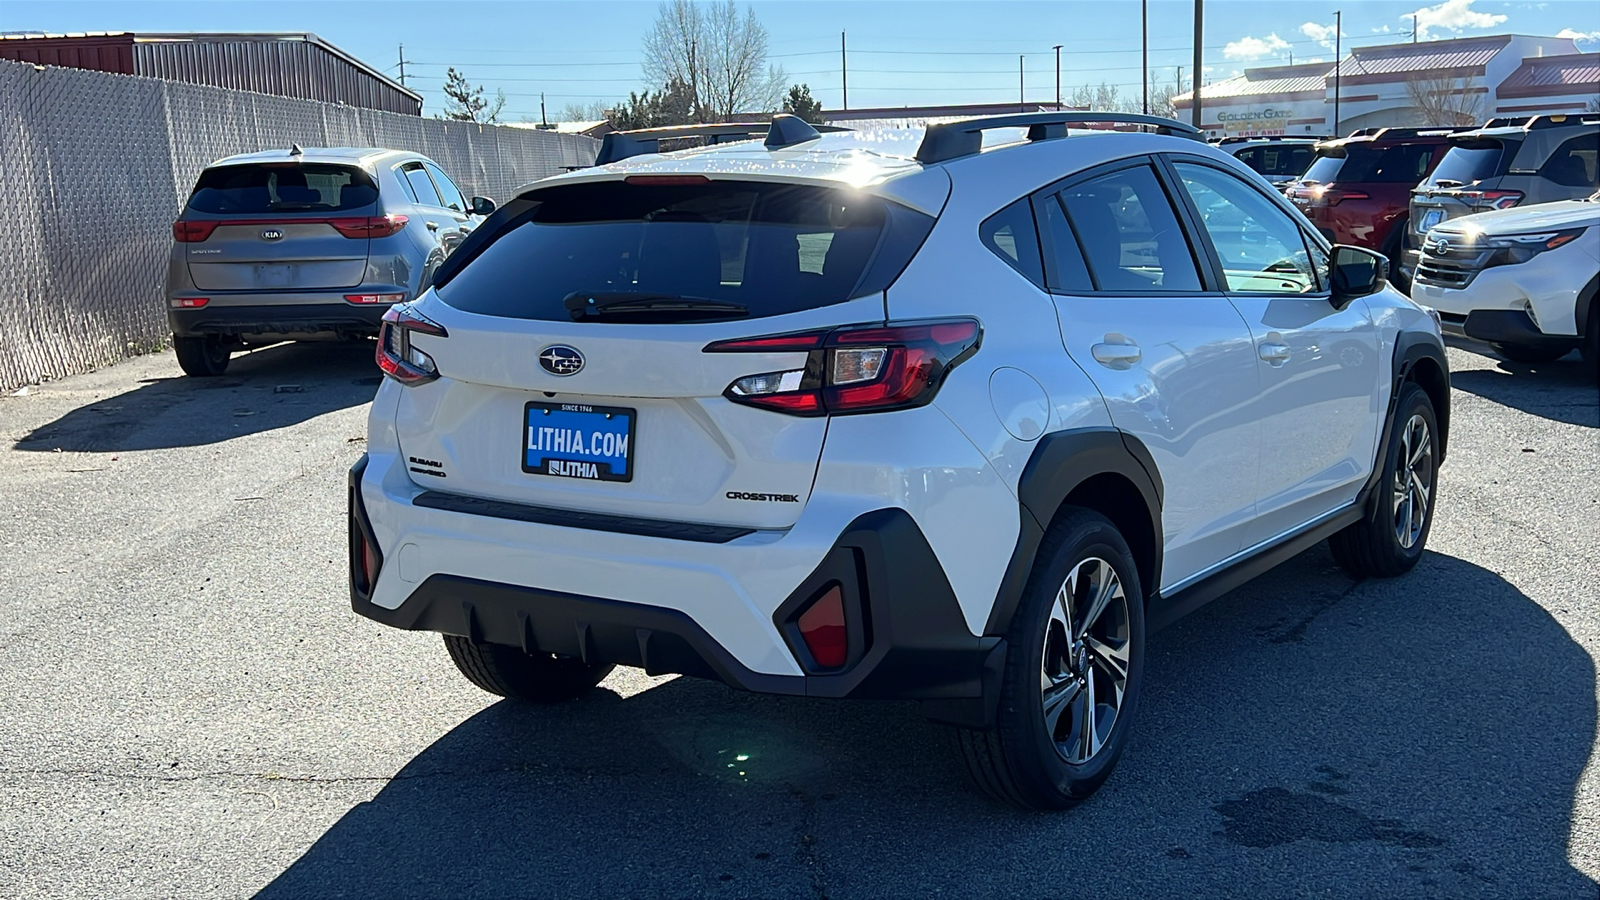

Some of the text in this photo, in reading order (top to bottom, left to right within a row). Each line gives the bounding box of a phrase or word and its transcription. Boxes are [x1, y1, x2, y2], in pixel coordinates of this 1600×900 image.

[561, 404, 593, 413] SINCE 1946
[527, 426, 629, 458] LITHIA.COM
[409, 456, 443, 468] SUBARU
[560, 461, 599, 479] LITHIA
[726, 491, 800, 503] CROSSTREK
